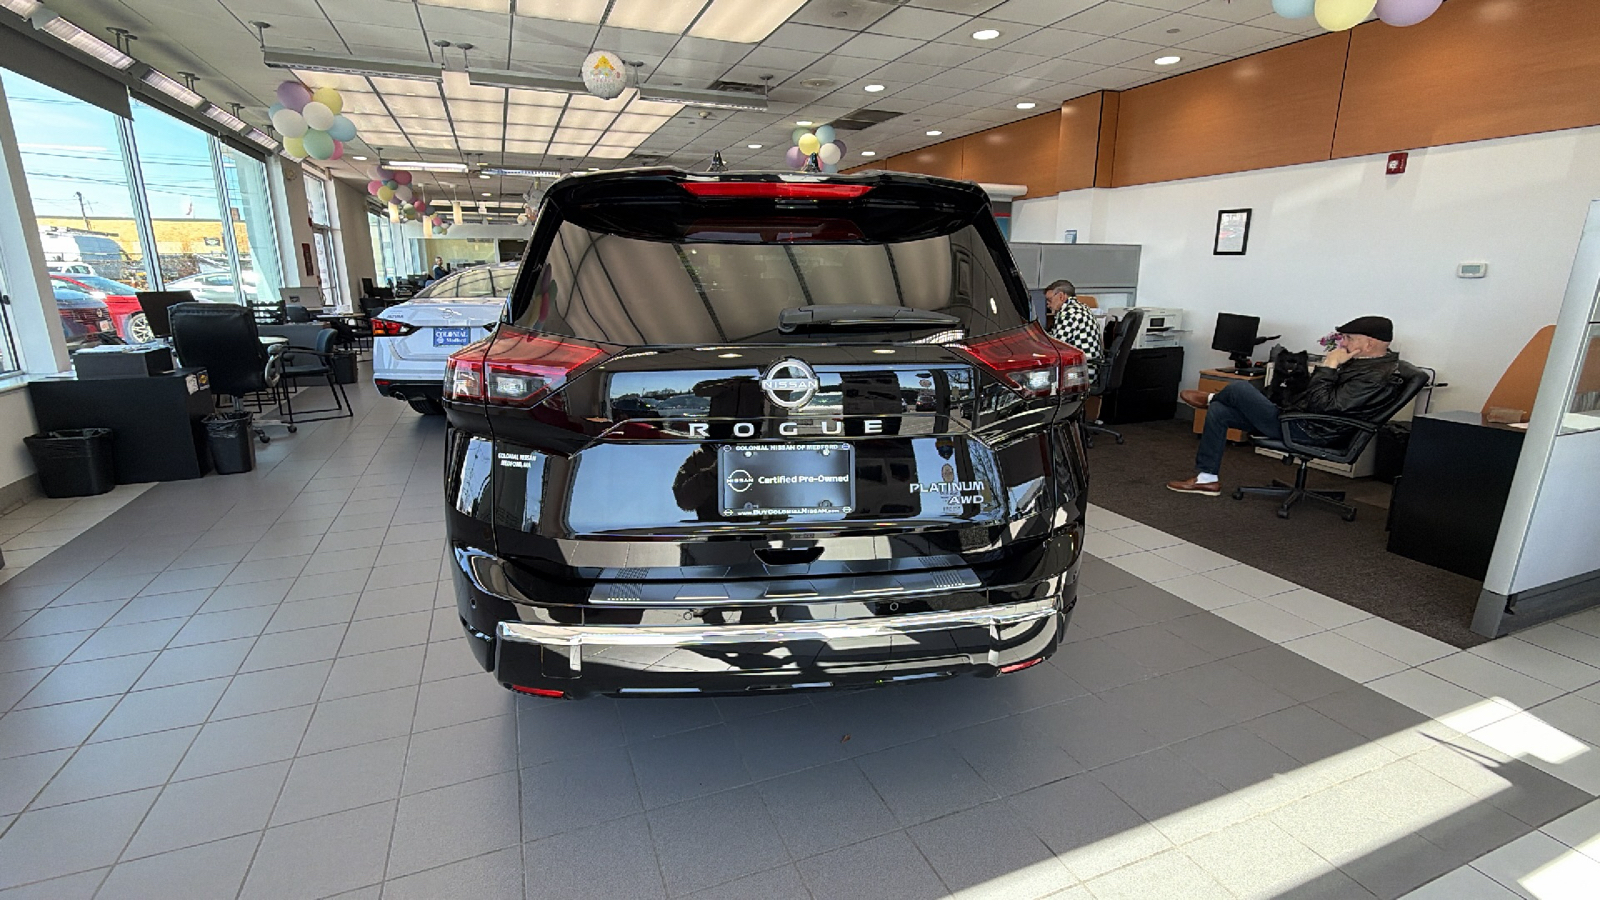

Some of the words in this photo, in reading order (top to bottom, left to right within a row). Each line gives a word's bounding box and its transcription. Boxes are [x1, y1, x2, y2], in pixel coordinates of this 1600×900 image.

[762, 380, 818, 389] NISSAN
[688, 419, 883, 439] ROGUE
[807, 443, 838, 451] MEDFORD
[758, 475, 797, 484] Certified
[798, 474, 849, 483] Pre-Owned
[909, 481, 985, 494] PLATINUM
[949, 495, 984, 504] AWD
